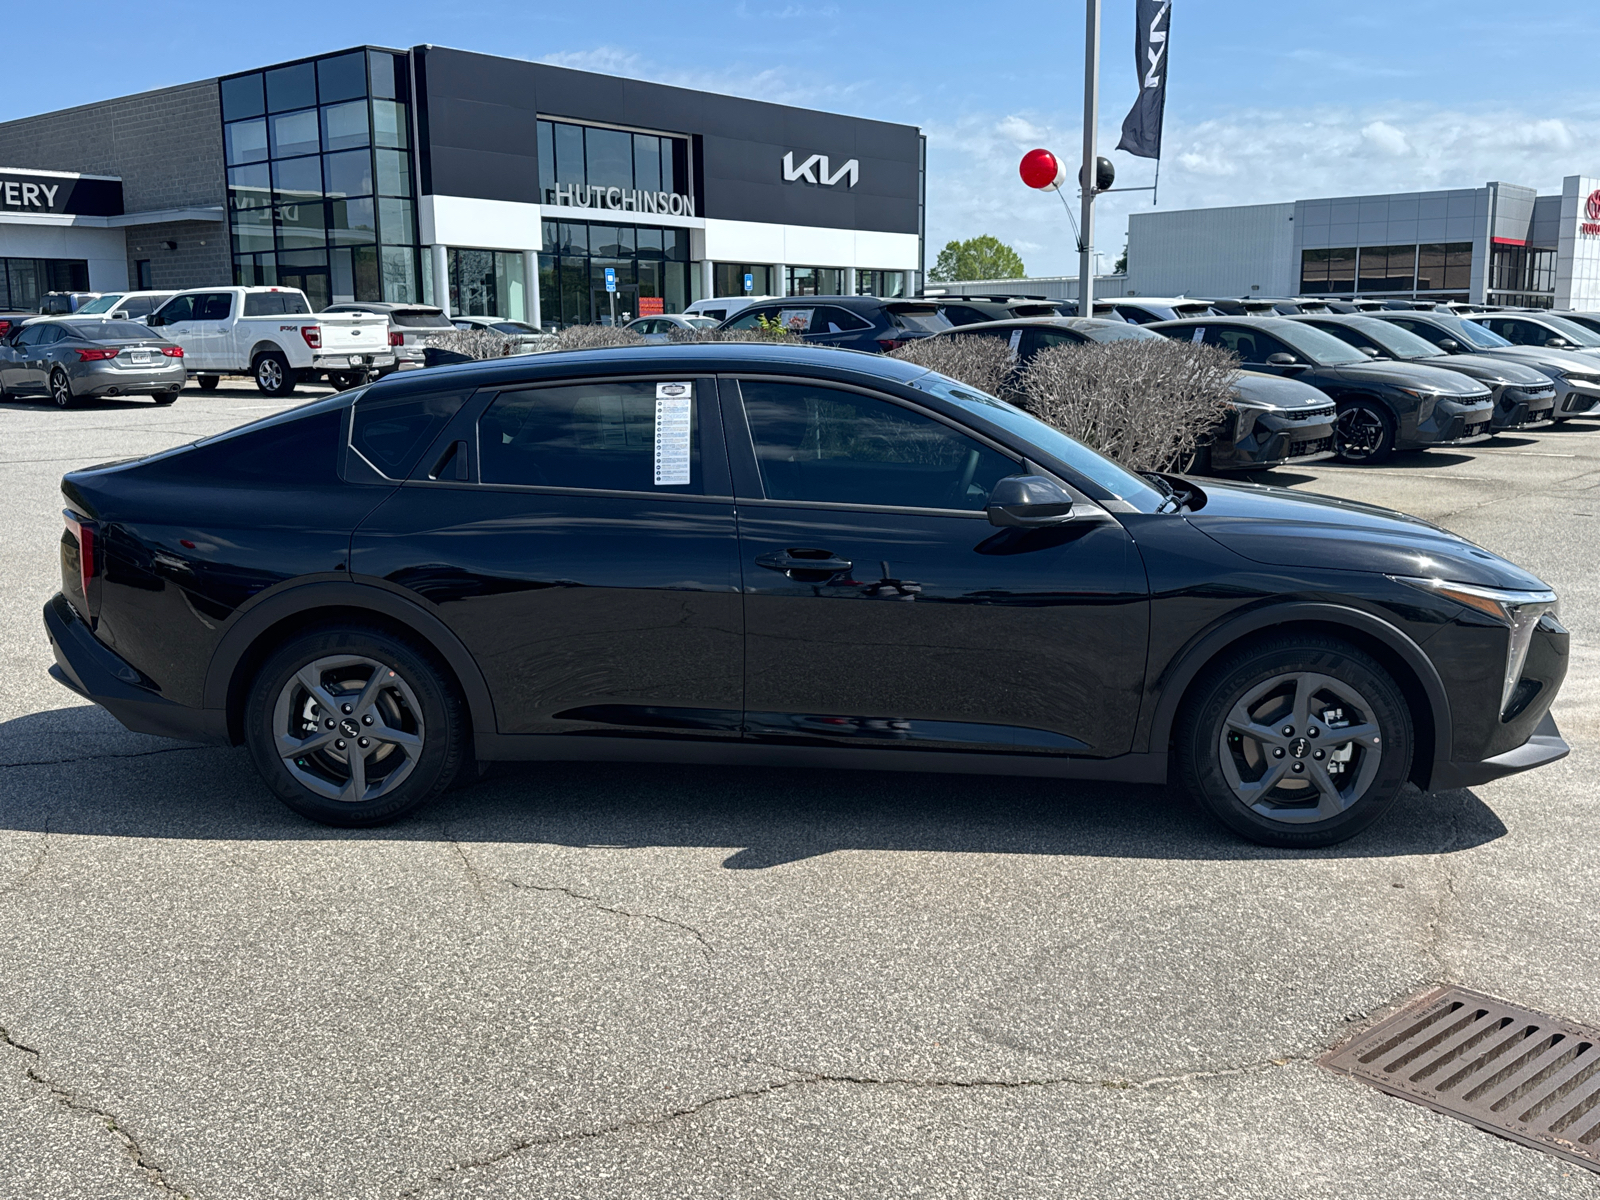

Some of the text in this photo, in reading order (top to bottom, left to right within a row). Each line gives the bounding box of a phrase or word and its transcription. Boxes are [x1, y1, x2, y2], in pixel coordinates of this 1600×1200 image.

[783, 151, 859, 187] KIA
[0, 181, 59, 207] ERY
[554, 182, 695, 217] HUTCHINSON
[255, 681, 271, 733] SOLUS
[1206, 675, 1246, 725] SOLUS
[350, 793, 410, 819] KUMHO
